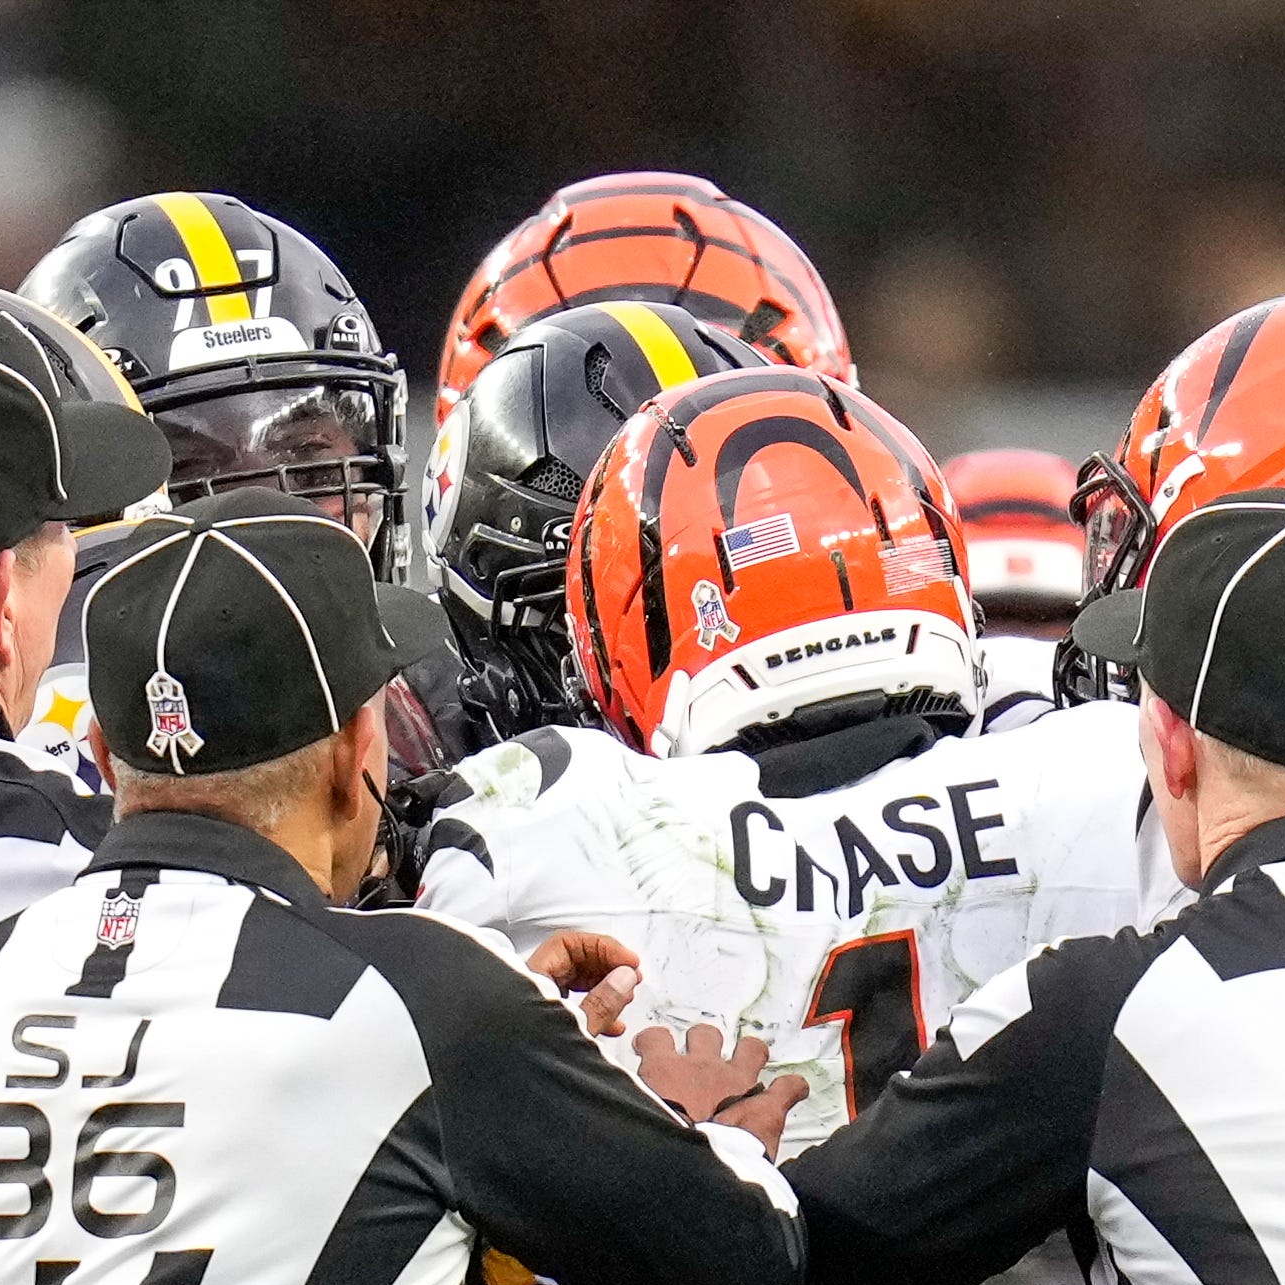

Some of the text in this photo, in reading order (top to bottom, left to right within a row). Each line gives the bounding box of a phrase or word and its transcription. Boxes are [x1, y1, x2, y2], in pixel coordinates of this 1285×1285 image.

[154, 249, 275, 332] 97
[203, 324, 273, 349] Steelers
[332, 332, 360, 344] OAKL
[701, 610, 724, 629] NFL
[765, 627, 898, 670] BENGALS
[157, 712, 187, 733] NFL
[729, 778, 1020, 920] CHASE
[99, 915, 138, 940] NFL
[5, 1014, 152, 1089] SJ
